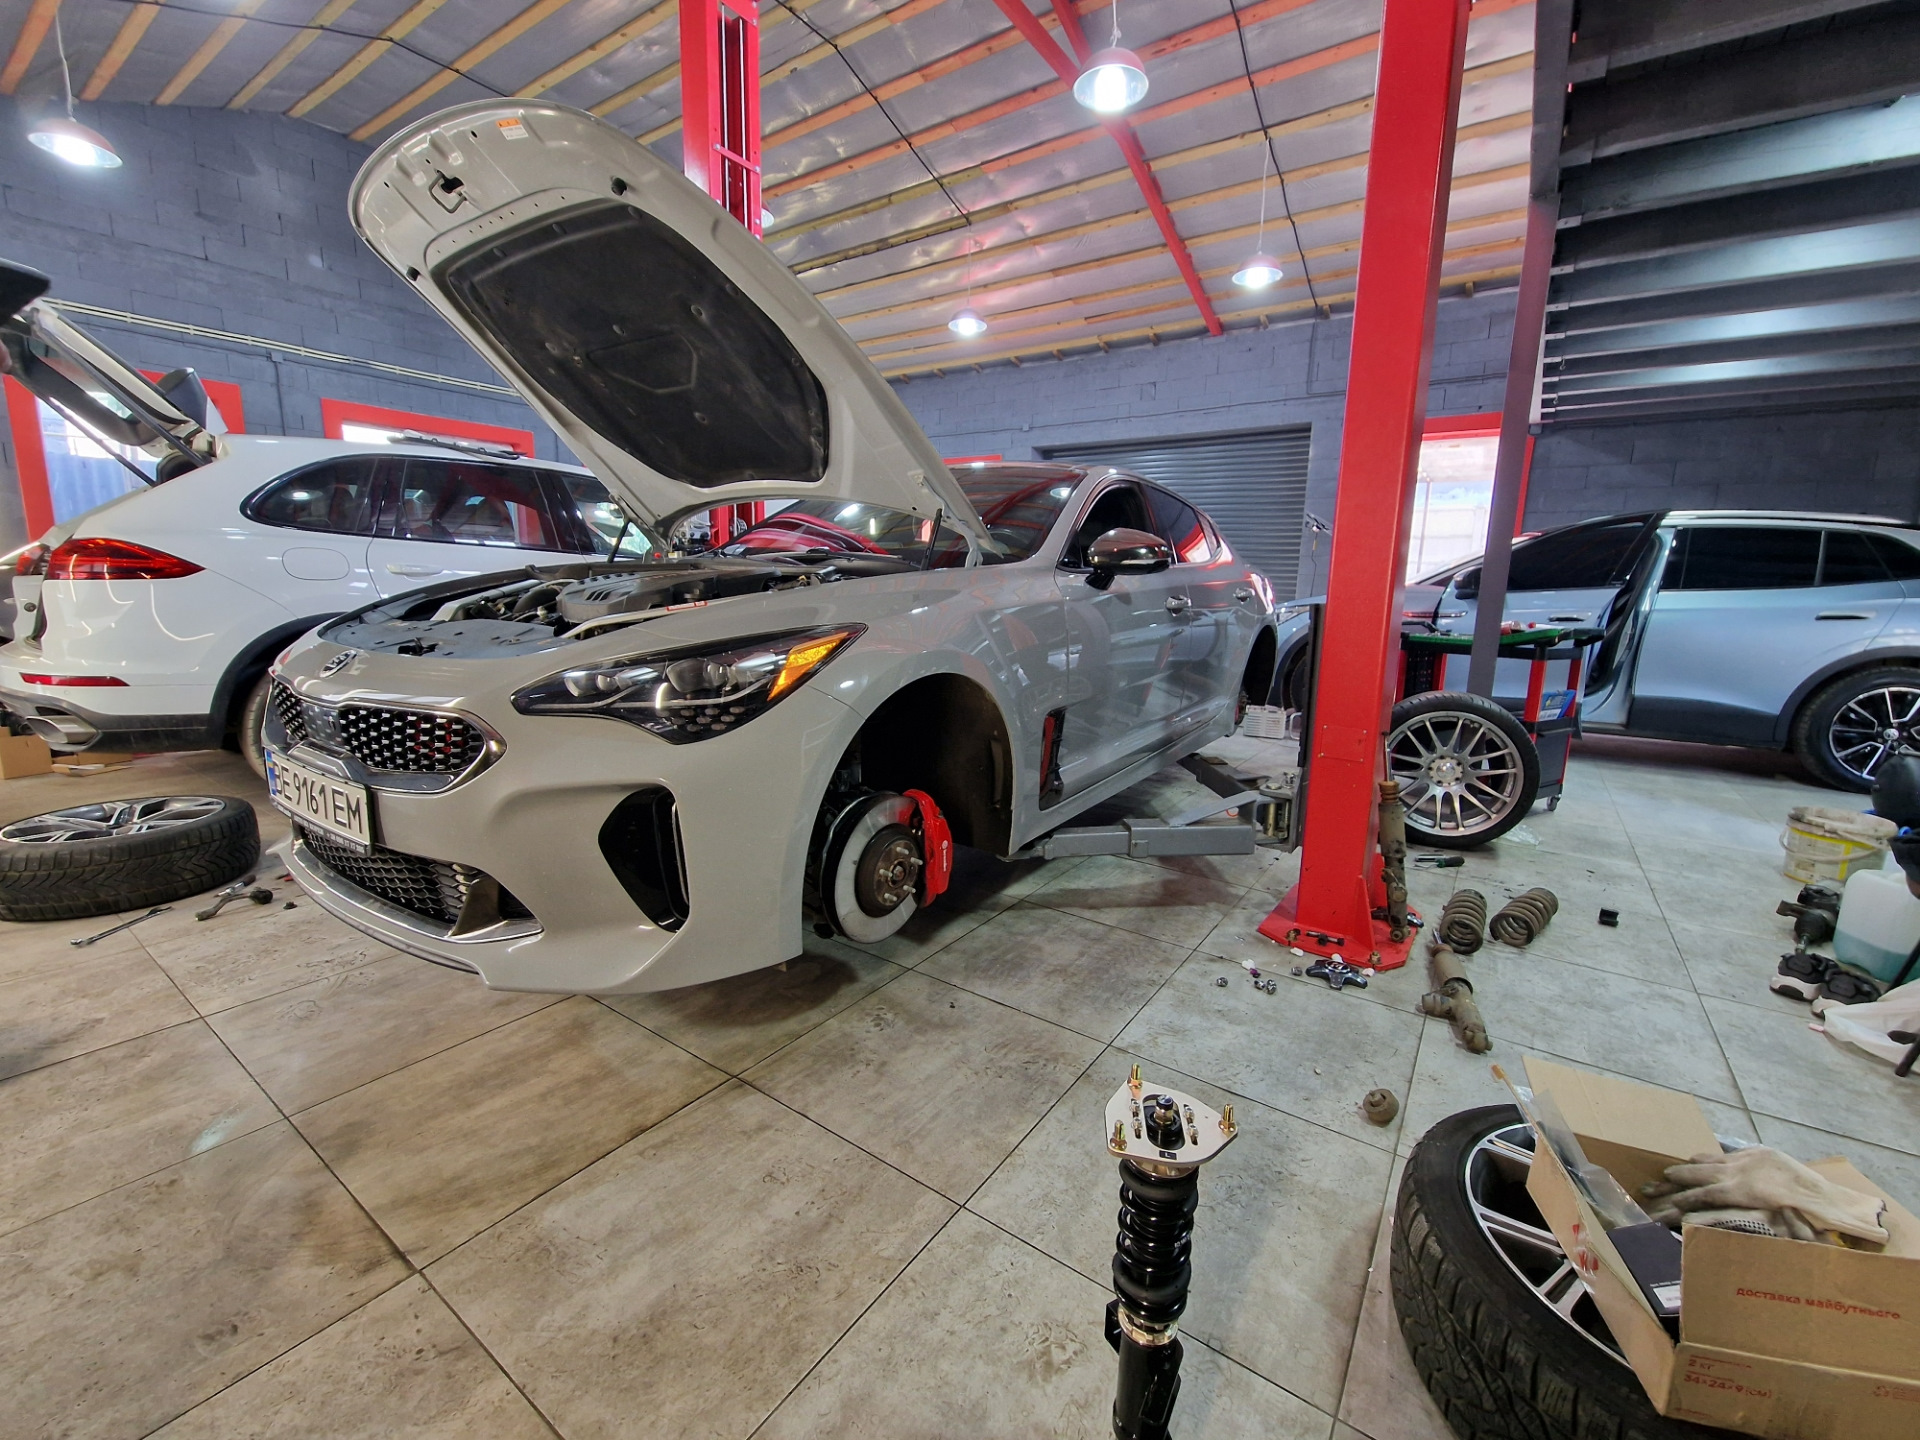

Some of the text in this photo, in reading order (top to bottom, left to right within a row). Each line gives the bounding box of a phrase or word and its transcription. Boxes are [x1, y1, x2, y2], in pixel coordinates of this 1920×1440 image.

[273, 760, 293, 802] BE
[293, 771, 329, 820] 9161
[331, 785, 363, 834] EM
[1736, 1287, 1801, 1304] доставка
[1687, 1359, 1697, 1368] 2
